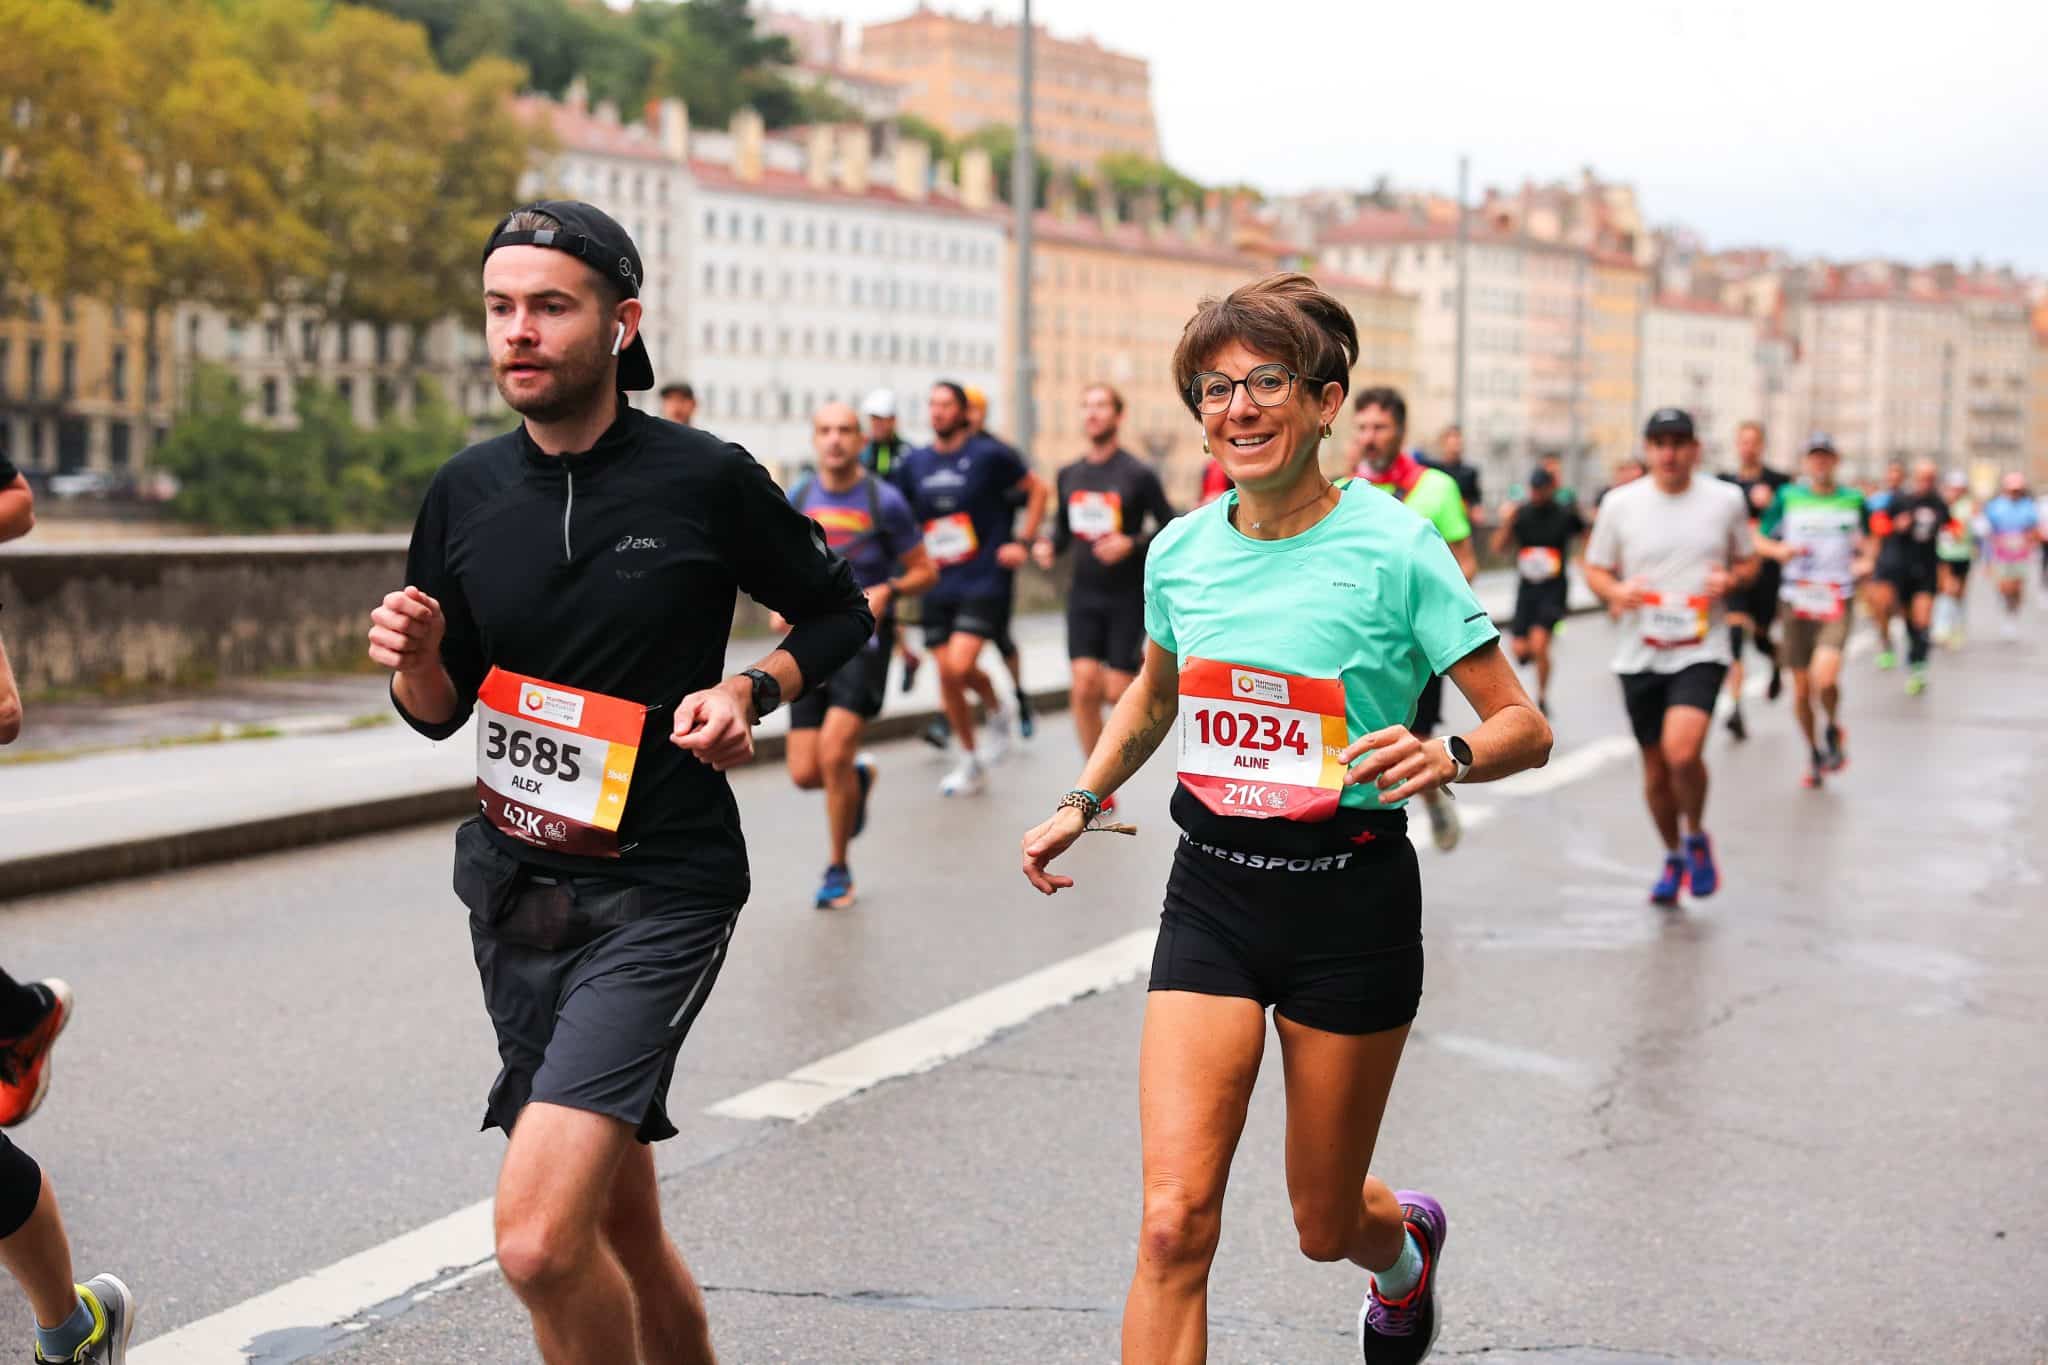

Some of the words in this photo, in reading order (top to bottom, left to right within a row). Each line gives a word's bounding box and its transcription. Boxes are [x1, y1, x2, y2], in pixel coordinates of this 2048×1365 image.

[1195, 709, 1308, 756] 10234
[486, 721, 581, 782] 3685
[1233, 755, 1270, 770] ALINE
[511, 775, 543, 795] ALEX
[1222, 783, 1267, 806] 21K
[503, 802, 544, 837] 42K
